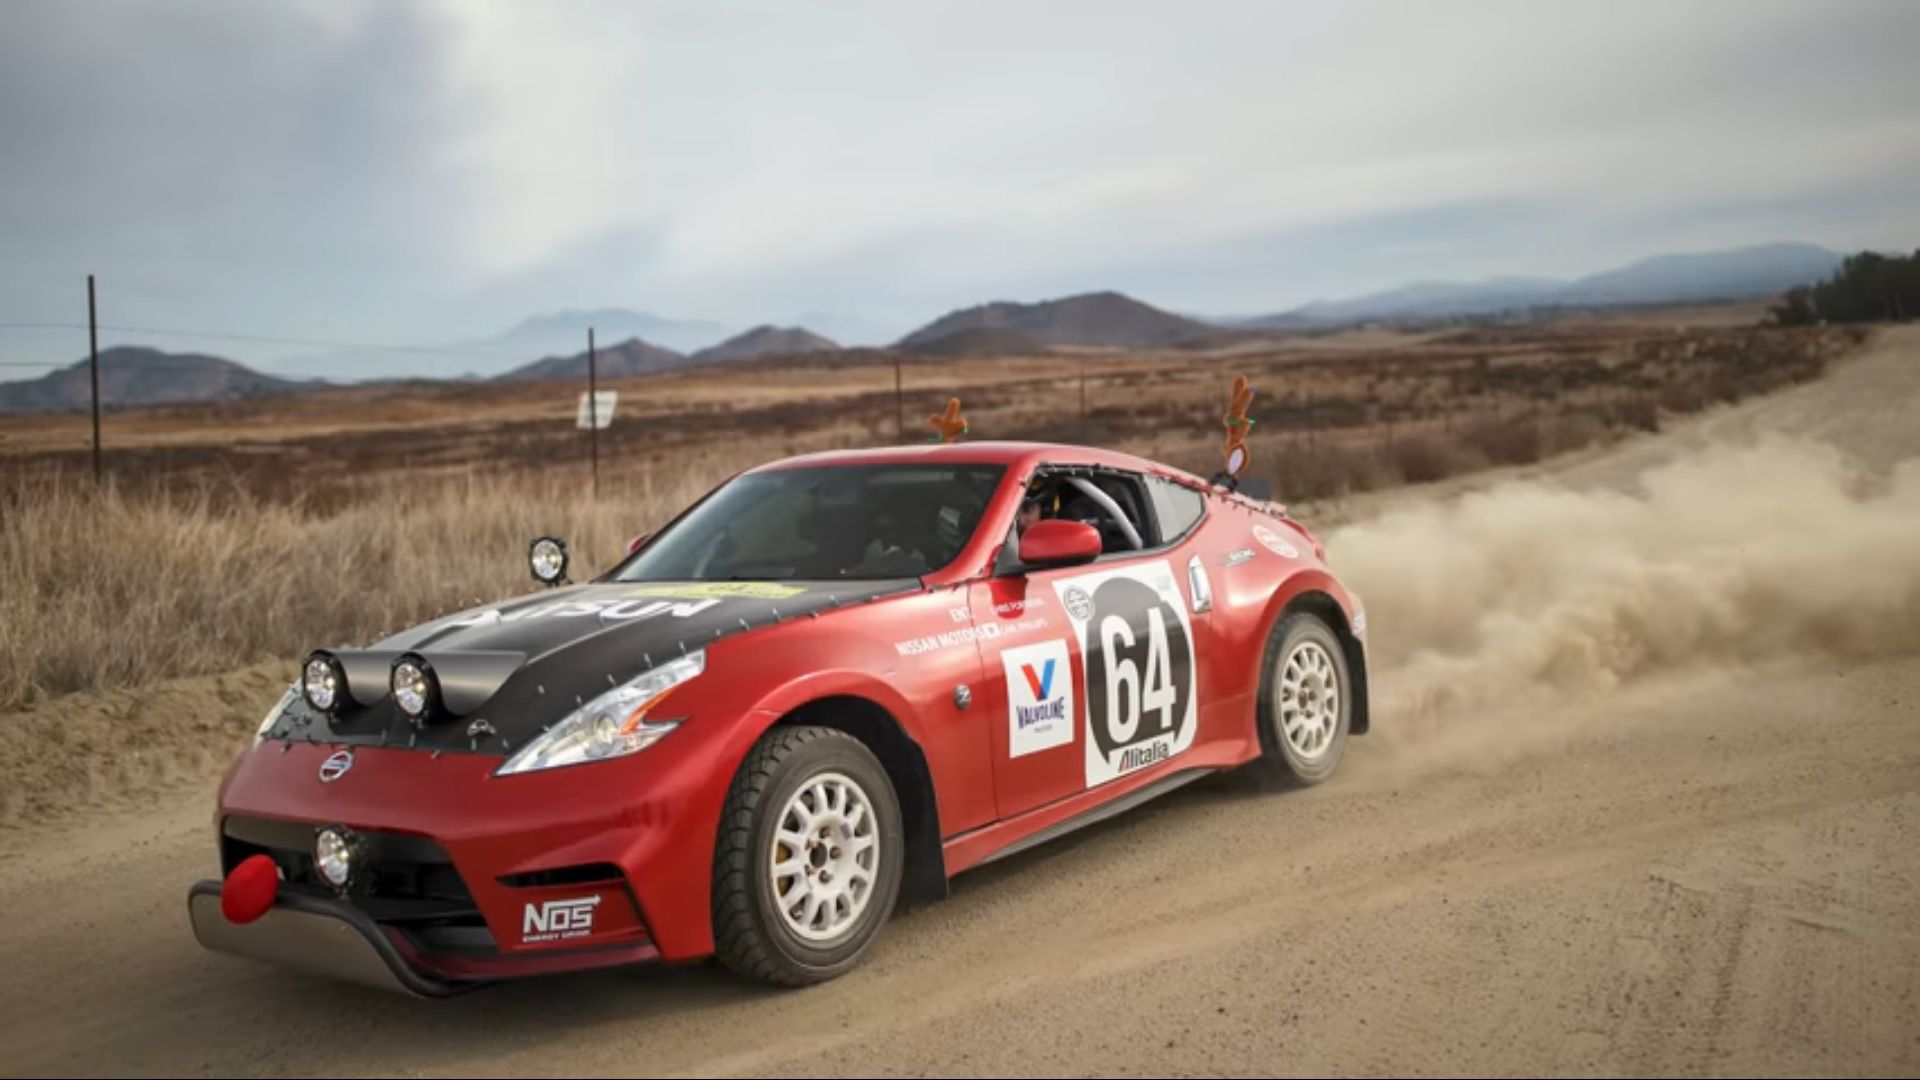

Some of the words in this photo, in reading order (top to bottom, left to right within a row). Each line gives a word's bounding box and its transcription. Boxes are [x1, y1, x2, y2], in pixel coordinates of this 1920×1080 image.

[1101, 606, 1177, 743] 64
[1016, 696, 1064, 729] VALVOLINE
[1117, 740, 1168, 773] Alitalia
[523, 894, 601, 933] NOS
